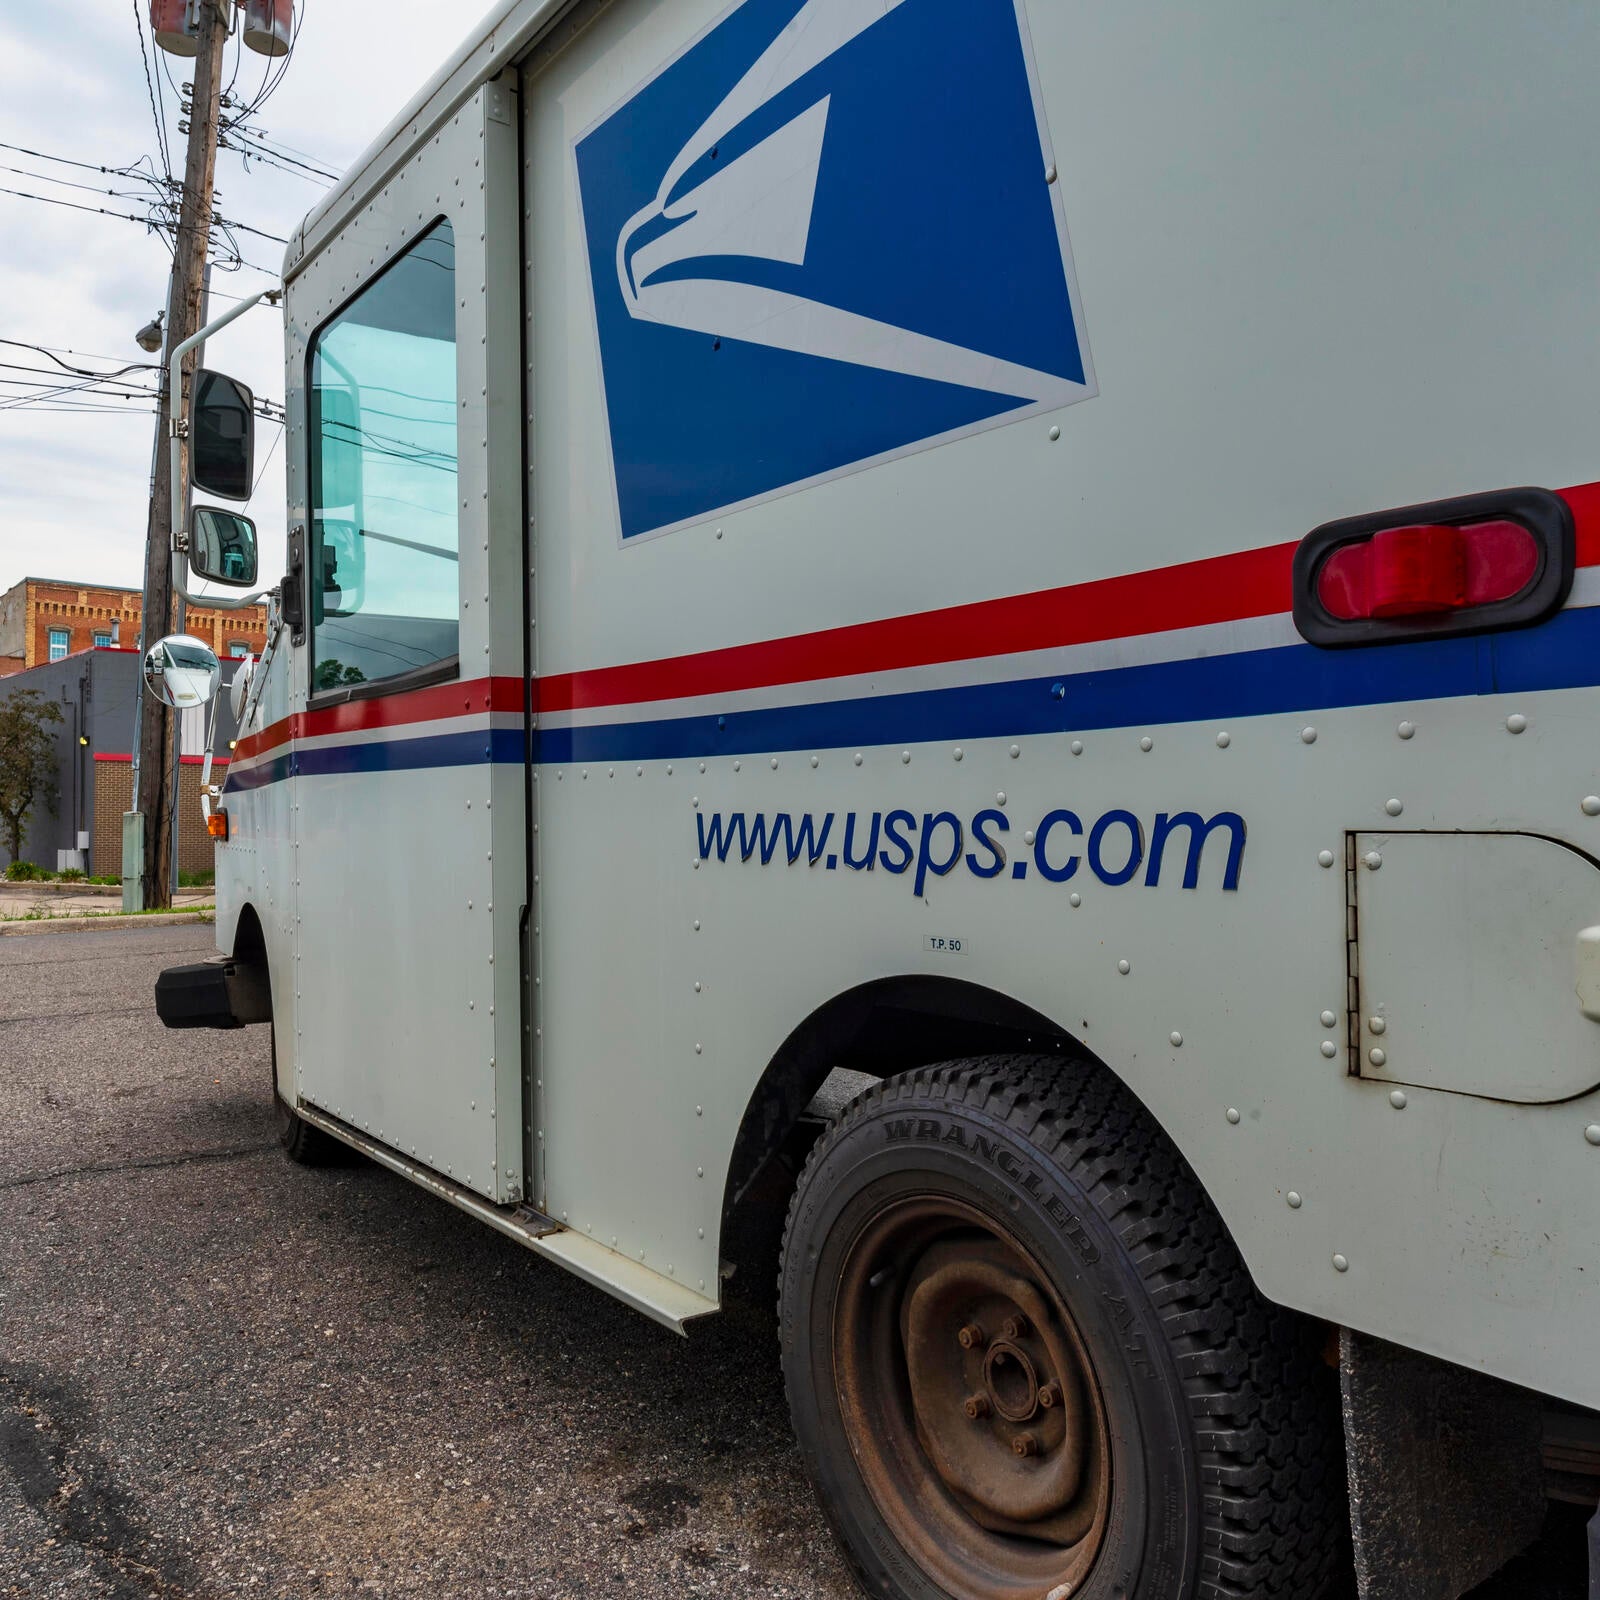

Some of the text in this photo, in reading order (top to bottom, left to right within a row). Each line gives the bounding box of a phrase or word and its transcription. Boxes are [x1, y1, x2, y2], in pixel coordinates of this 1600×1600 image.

[696, 808, 1247, 898] www.usps.com
[930, 938, 961, 951] T.P. 50
[884, 1118, 1101, 1265] WRANGLER
